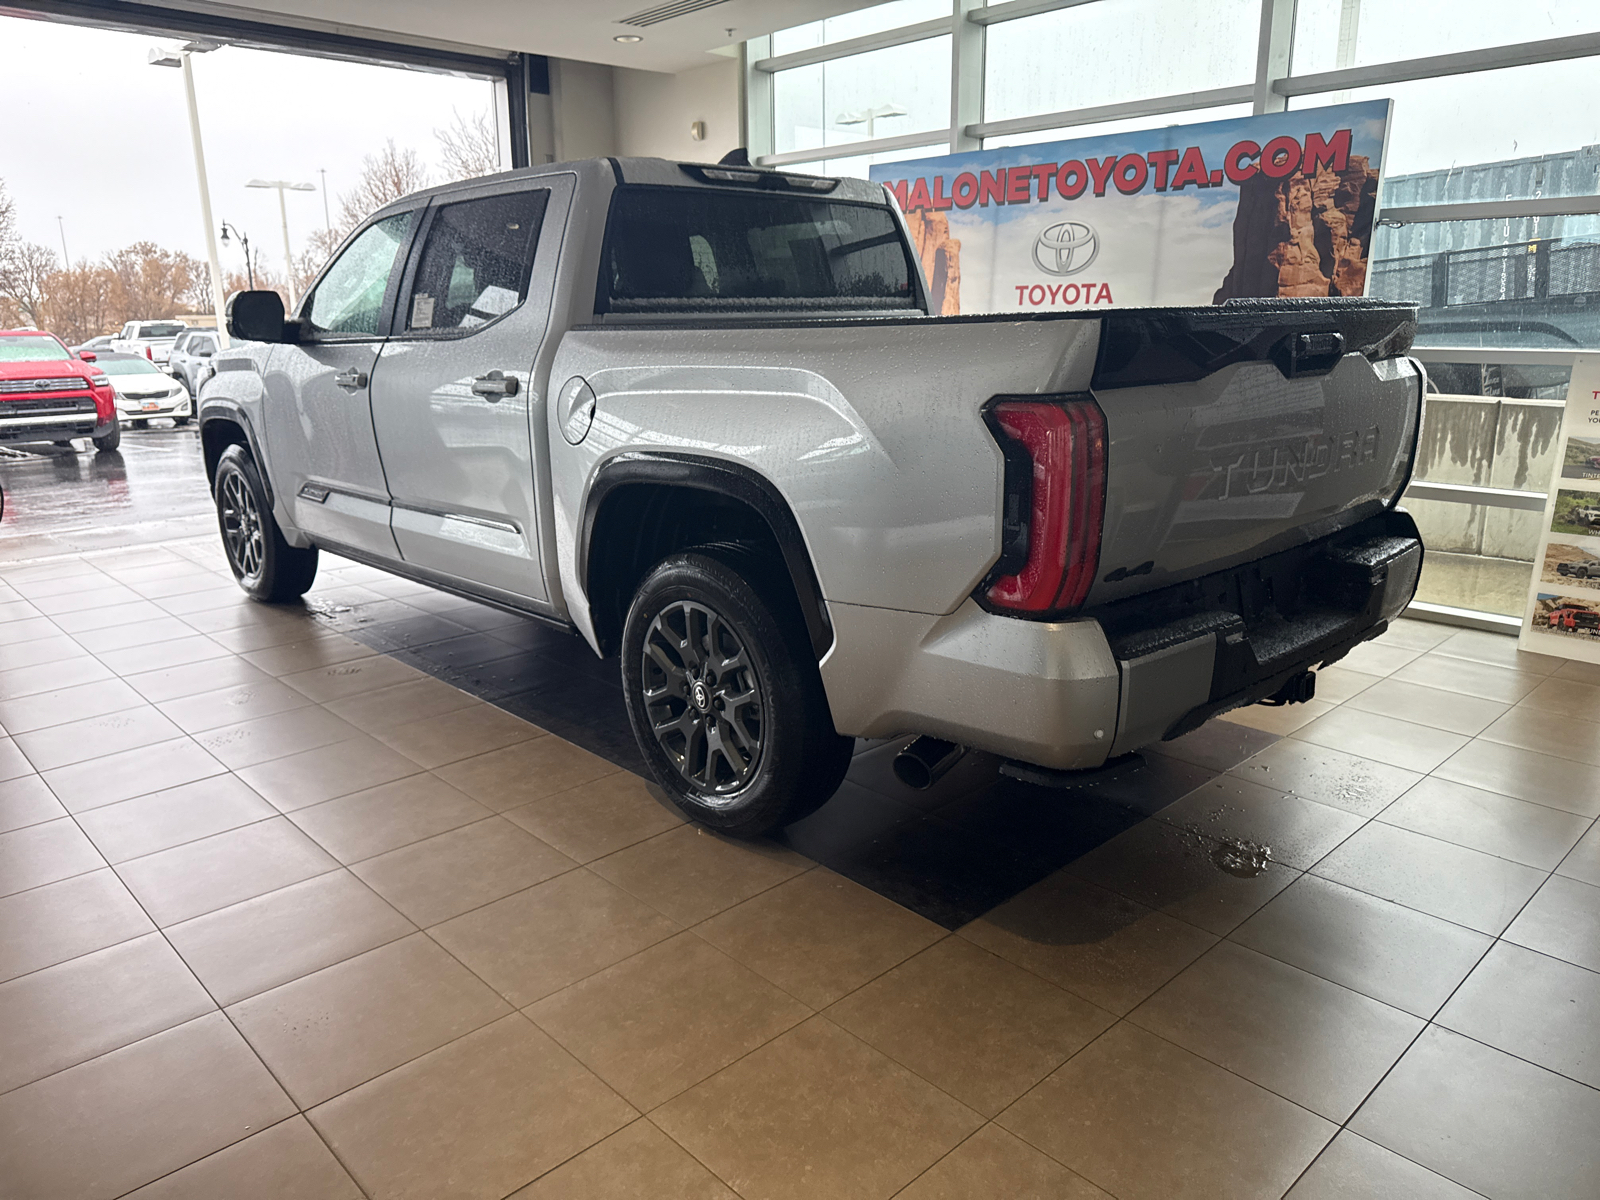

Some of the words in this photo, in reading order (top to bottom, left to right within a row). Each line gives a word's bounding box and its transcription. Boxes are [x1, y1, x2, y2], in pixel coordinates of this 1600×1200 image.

[883, 129, 1353, 213] MALONETOYOTA.COM
[1015, 282, 1113, 306] TOYOTA
[1209, 424, 1380, 501] TUNDRA
